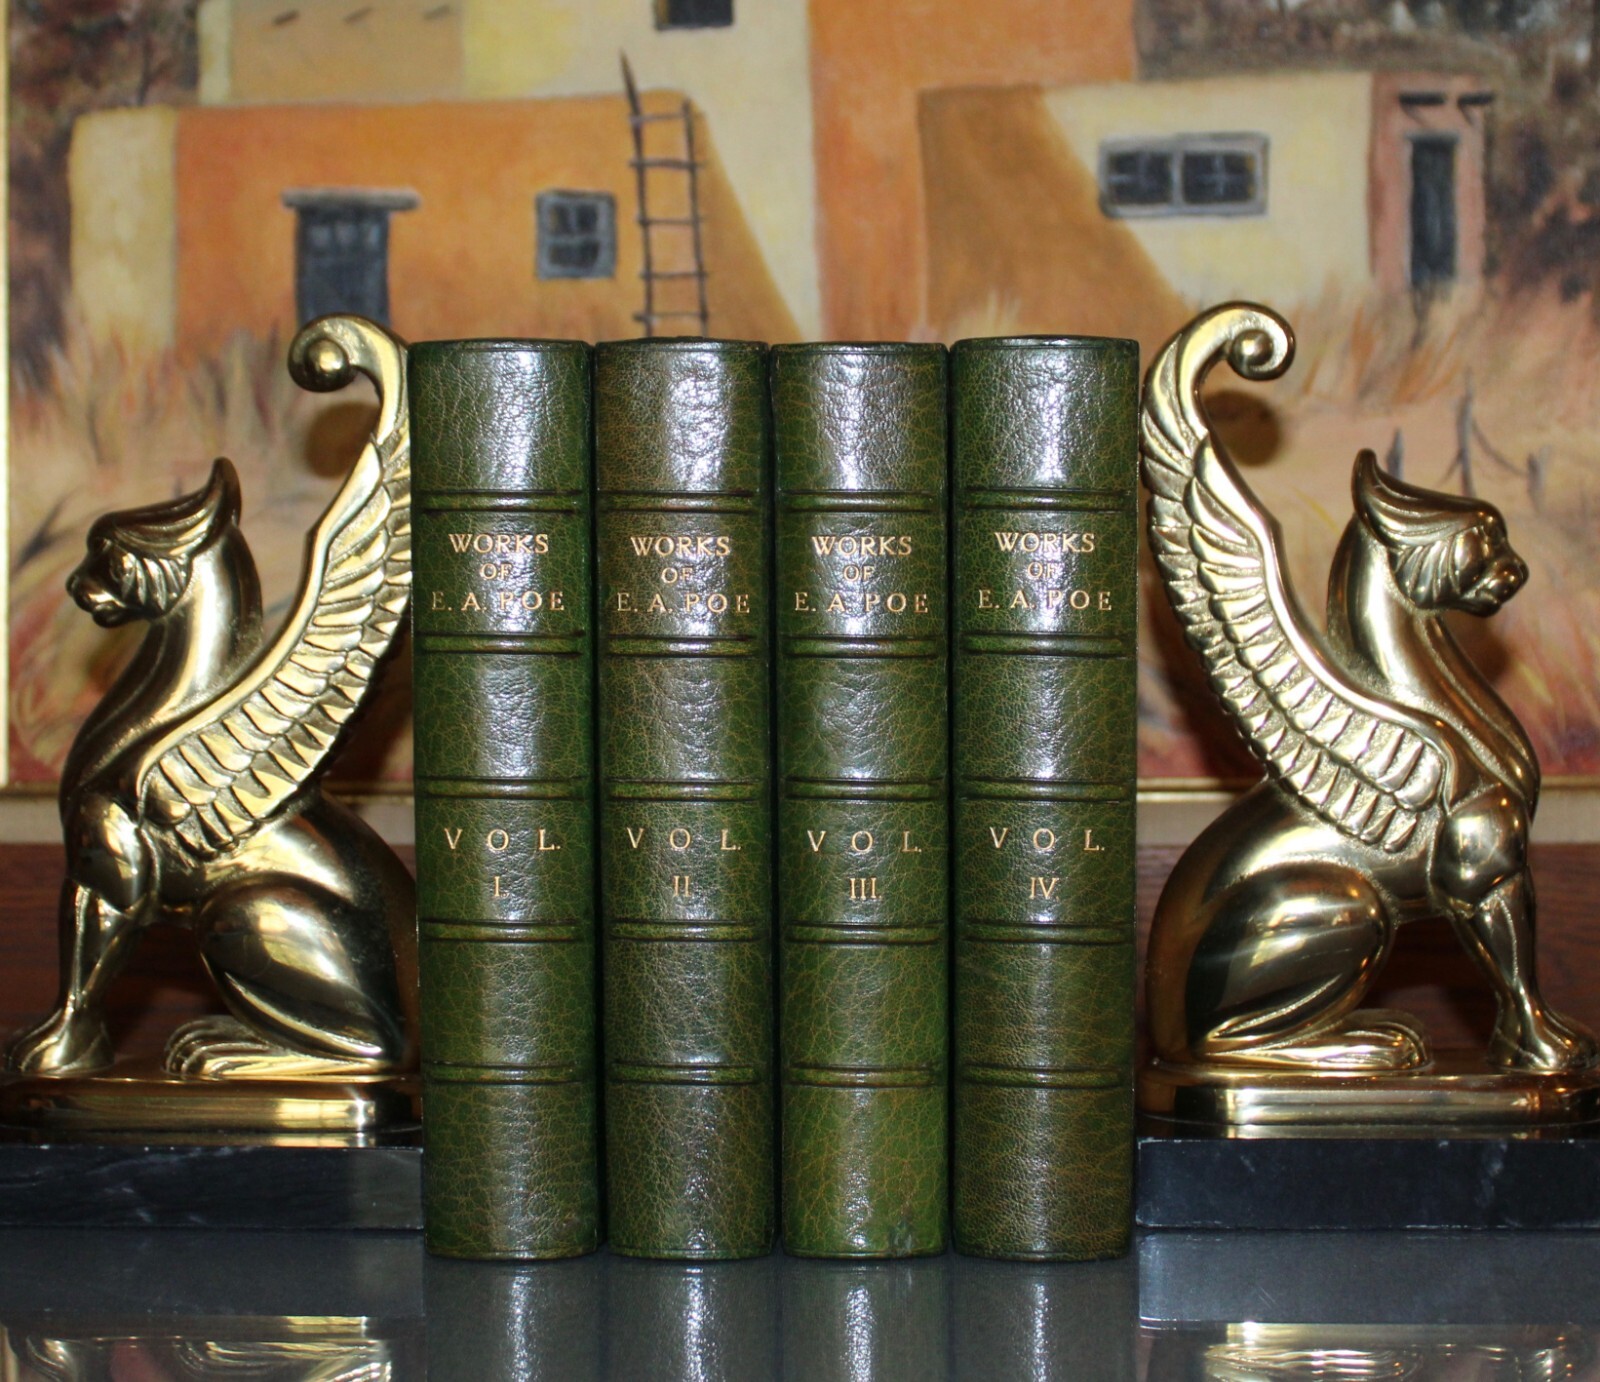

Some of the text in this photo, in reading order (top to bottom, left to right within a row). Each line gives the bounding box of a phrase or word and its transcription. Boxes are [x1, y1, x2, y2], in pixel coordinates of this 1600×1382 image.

[449, 533, 549, 554] WORKS
[631, 536, 731, 556] WORKS
[811, 536, 912, 556] WORKS
[995, 532, 1095, 553] WORKS
[480, 563, 513, 580] OF
[661, 567, 693, 584] OF
[843, 564, 875, 581] OF
[1027, 562, 1058, 579] OF
[431, 591, 565, 612] E. A. POE
[617, 593, 750, 613] E. A. POE
[795, 592, 928, 613] E. A. POE
[978, 590, 1112, 611] E. A. POE
[444, 828, 561, 851] VOL.
[807, 829, 922, 852] VOL.
[989, 826, 1105, 851] VOL.
